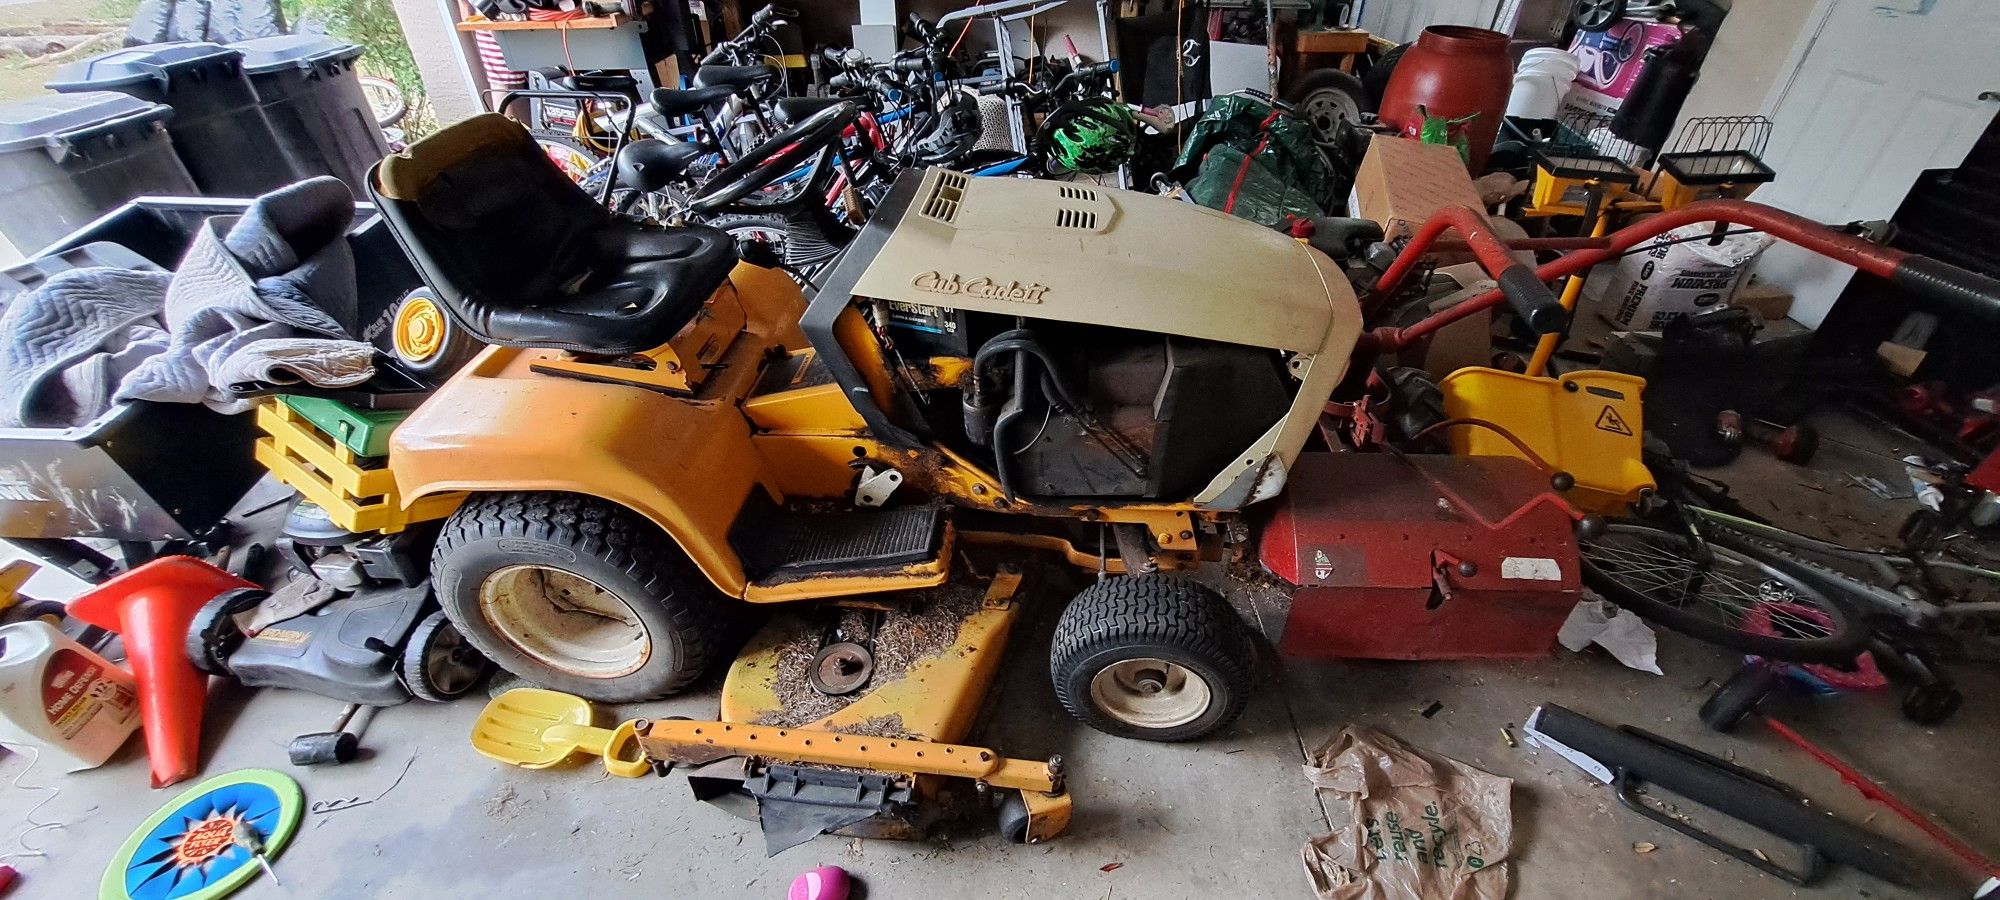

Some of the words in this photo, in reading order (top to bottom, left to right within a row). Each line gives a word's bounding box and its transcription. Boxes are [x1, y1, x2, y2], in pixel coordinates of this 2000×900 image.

[911, 271, 960, 295] Cub
[47, 690, 74, 715] HOME
[1386, 811, 1408, 861] reuse
[1404, 827, 1428, 864] and
